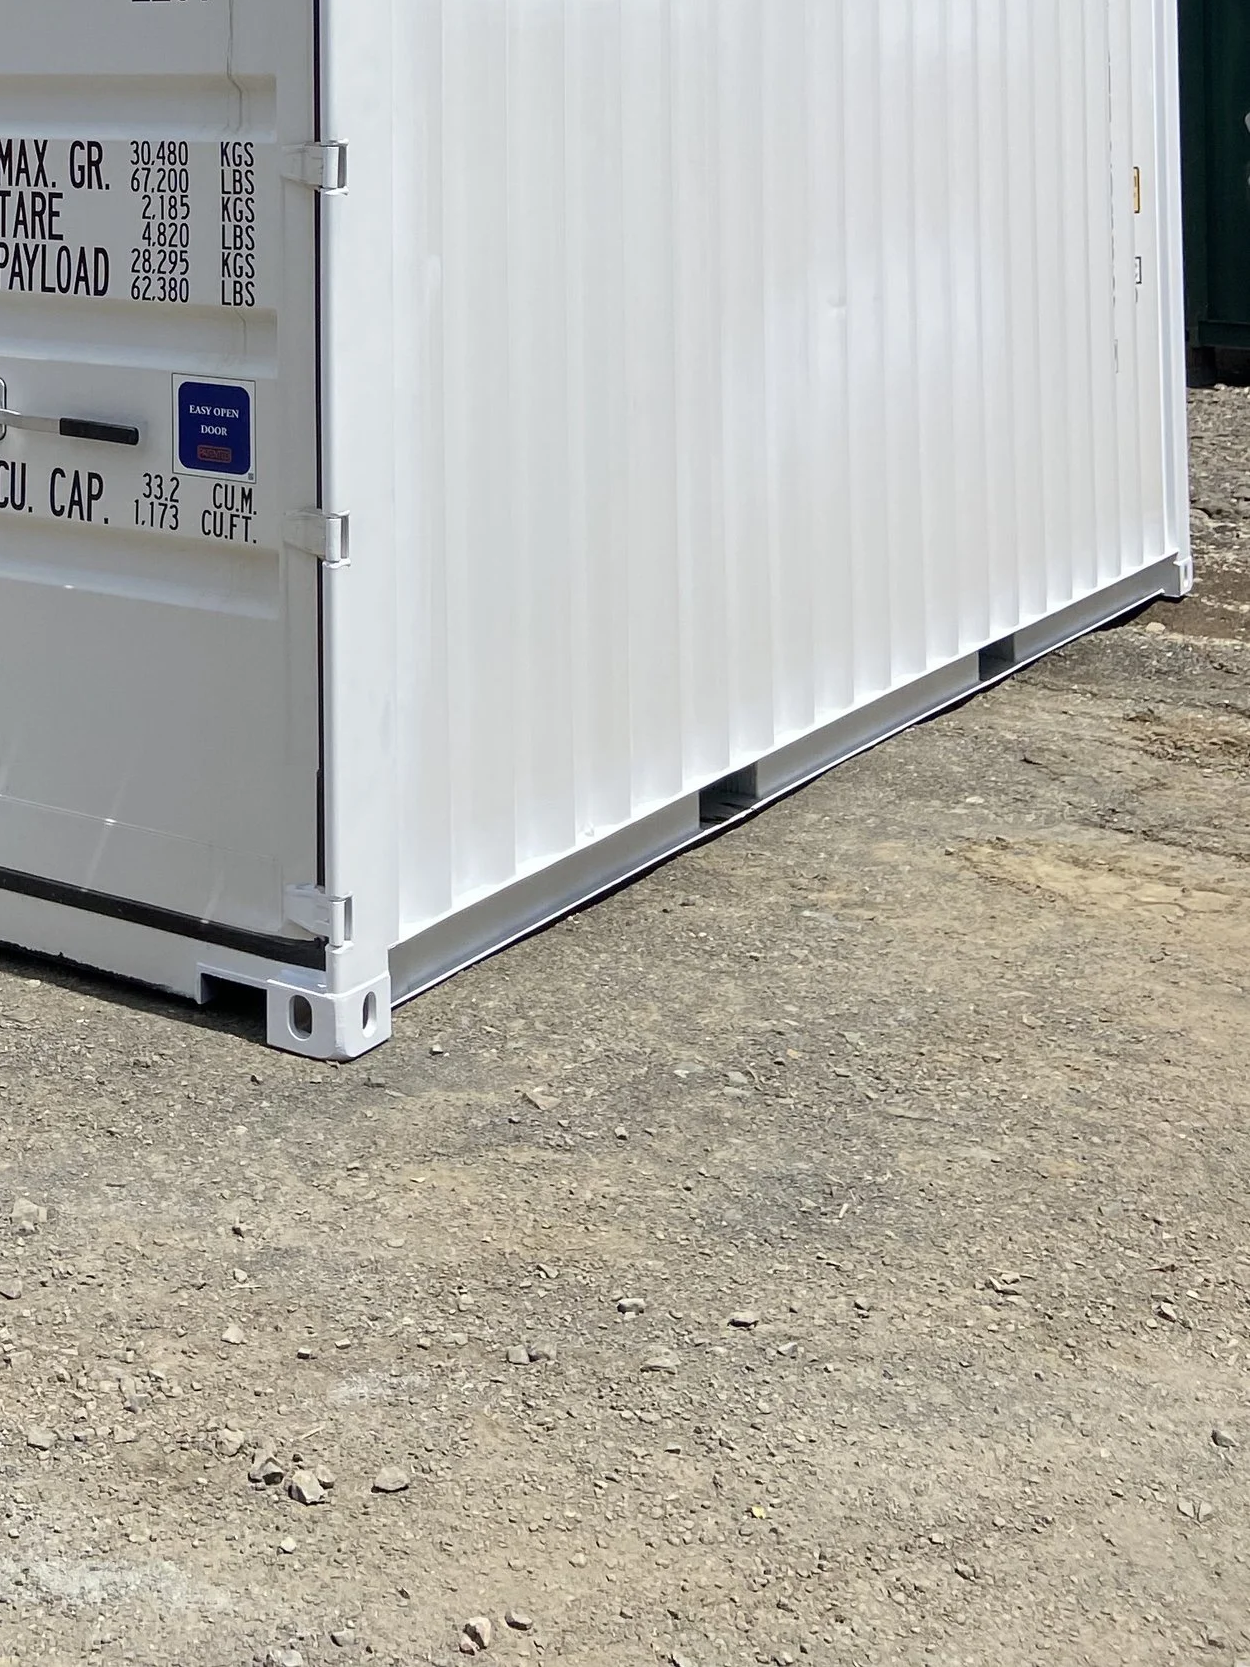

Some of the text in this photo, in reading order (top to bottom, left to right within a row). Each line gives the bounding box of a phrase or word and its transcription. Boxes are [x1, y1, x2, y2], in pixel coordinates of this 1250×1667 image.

[69, 140, 110, 191] GR.
[130, 140, 189, 166] 30,480
[220, 141, 255, 167] KGS
[130, 167, 255, 195] 67,200 LBS
[141, 194, 191, 220] 2,185
[221, 196, 255, 223] KGS
[142, 221, 255, 251] 4,820 LBS
[131, 248, 190, 276] 28,295
[221, 251, 255, 279] KGS
[131, 275, 255, 307] 62,380 LBS
[189, 404, 239, 419] EASY OPEN
[200, 424, 227, 436] DOOR
[50, 467, 109, 525] CAP.
[142, 472, 180, 503] 33.2
[212, 482, 257, 515] CU.M.
[134, 499, 257, 544] 1,173 CU.FT.
